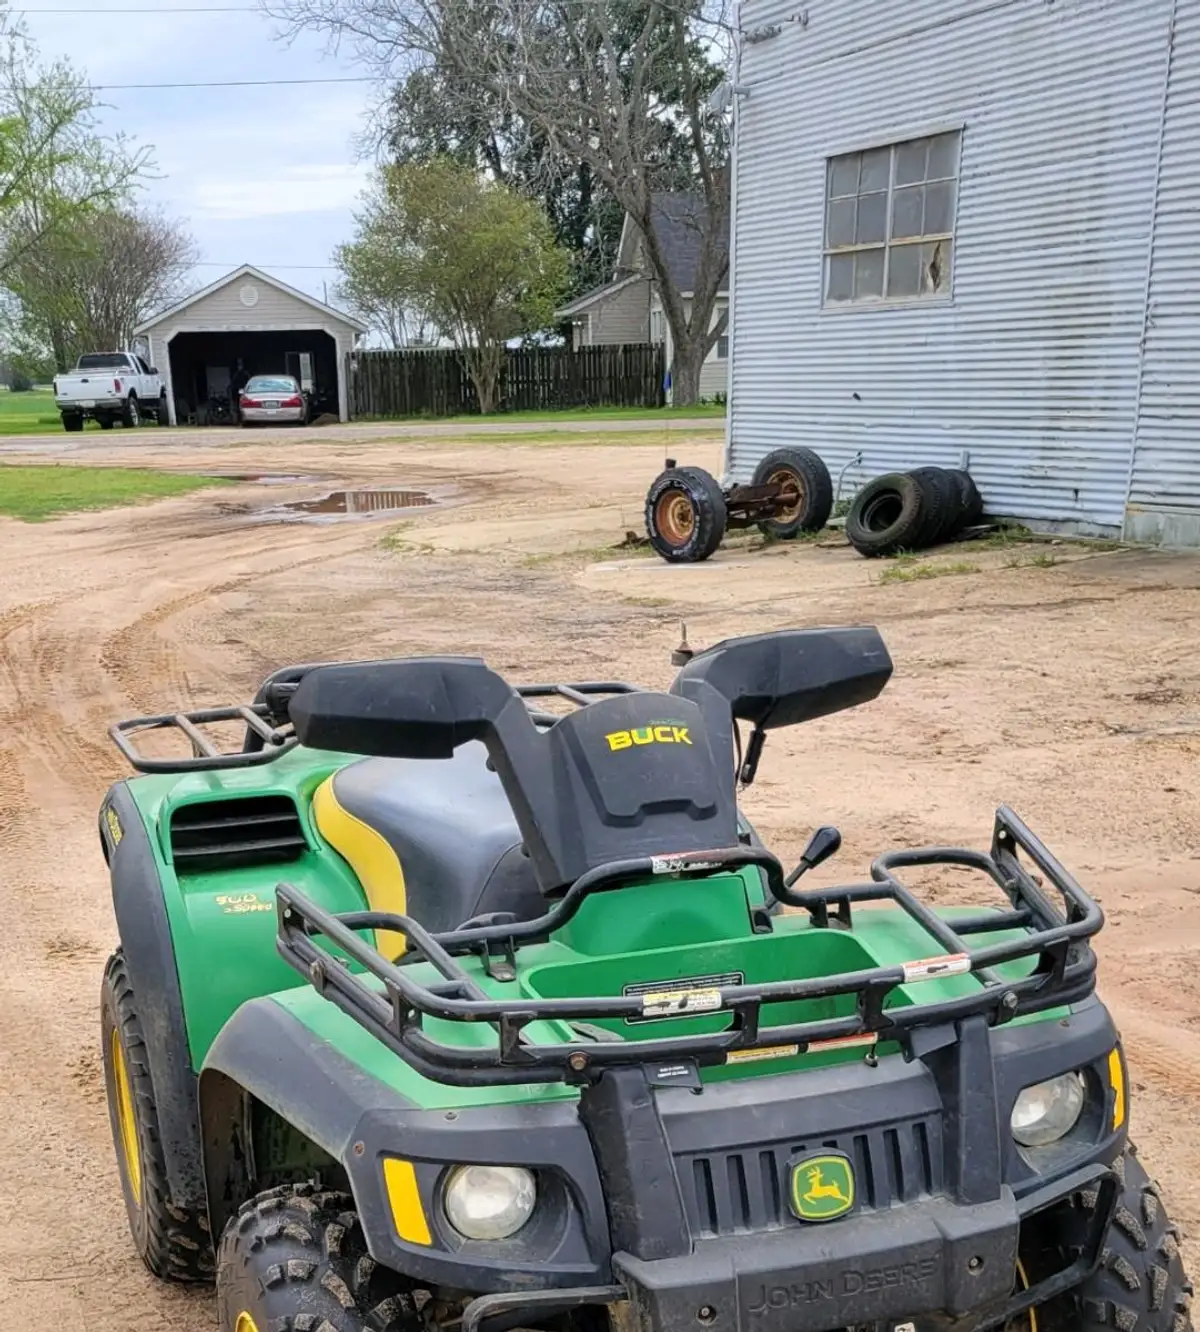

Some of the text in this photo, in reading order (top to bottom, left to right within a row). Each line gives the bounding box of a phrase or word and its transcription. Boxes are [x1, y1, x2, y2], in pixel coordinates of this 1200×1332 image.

[605, 726, 693, 750] BUCK
[749, 1258, 936, 1313] JOHN DEERE
